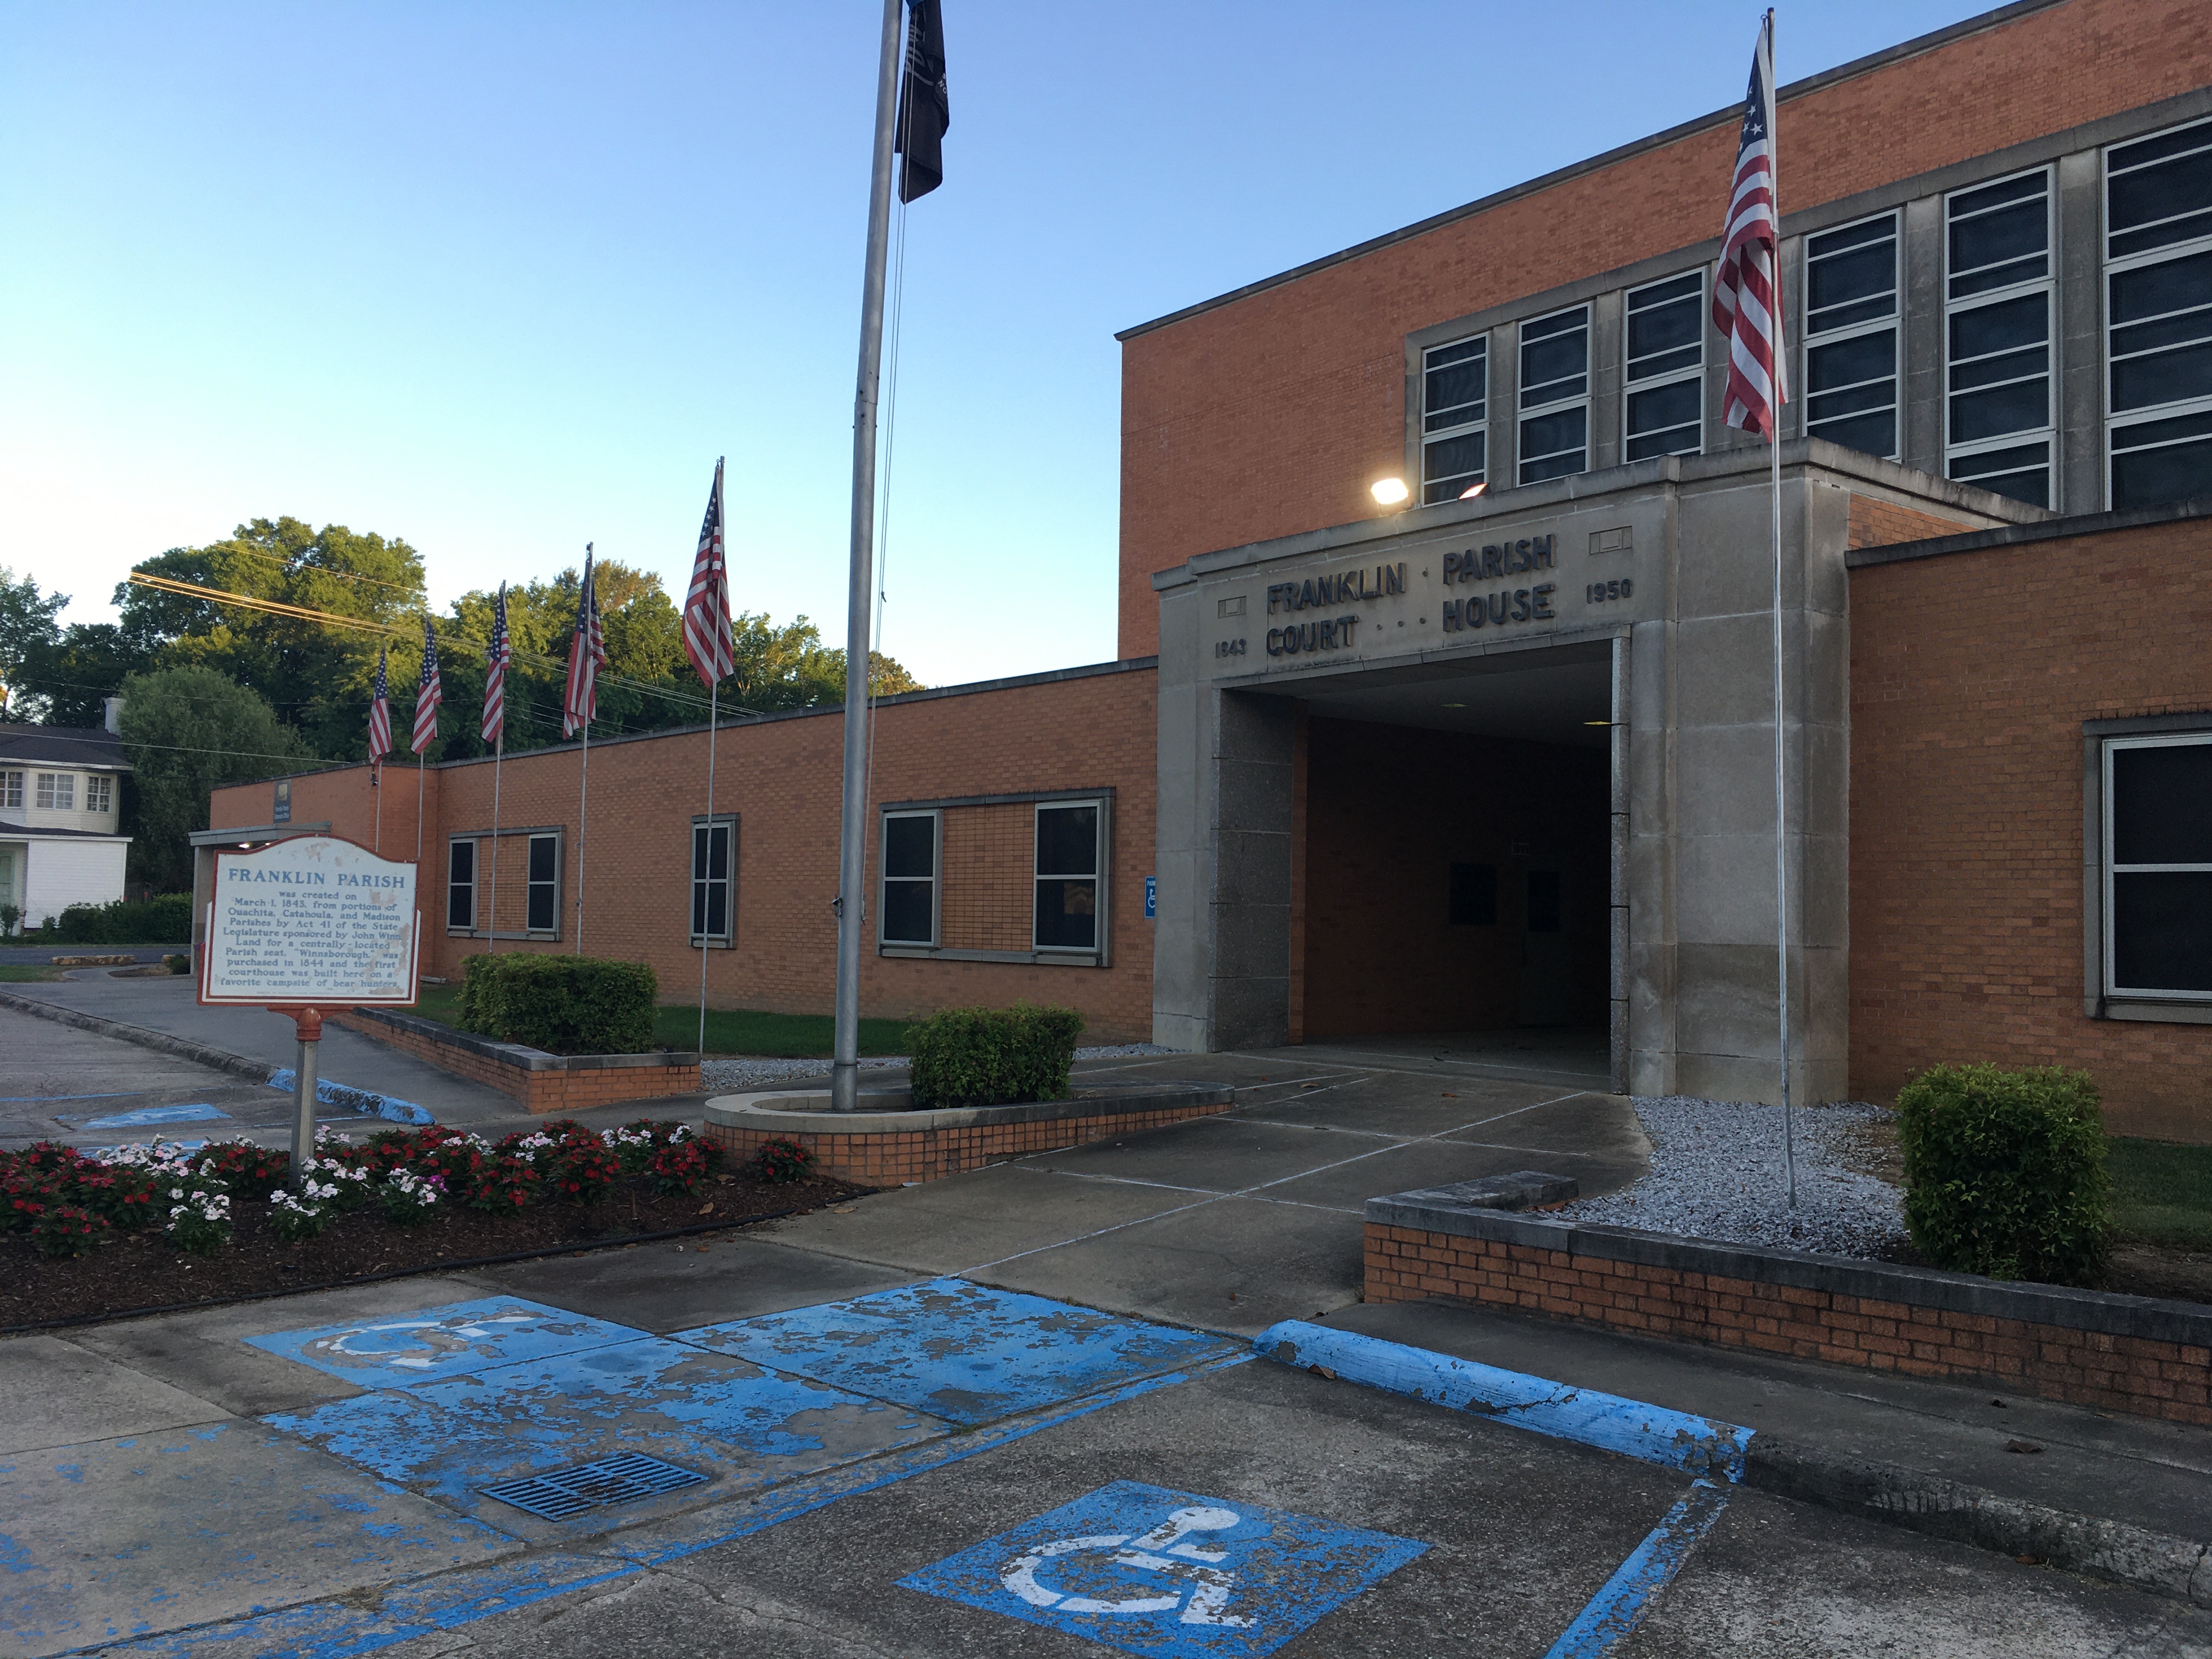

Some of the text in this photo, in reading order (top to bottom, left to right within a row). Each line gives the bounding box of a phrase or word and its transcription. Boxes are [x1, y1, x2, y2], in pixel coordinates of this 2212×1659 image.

[1267, 534, 1556, 614] FRANKLIN PARISH
[1586, 578, 1633, 604] 1950
[1266, 583, 1555, 657] COURT HOUSE
[1215, 639, 1246, 659] 1843
[228, 868, 405, 889] FRANKLIN PARISH
[302, 891, 339, 900] created
[234, 897, 266, 906] March
[313, 900, 336, 909] from
[341, 903, 382, 911] portions
[363, 912, 400, 921] Madison
[229, 917, 271, 926] Parishes
[276, 918, 290, 928] by
[373, 922, 398, 930] State
[223, 927, 280, 938] Legislature
[283, 930, 332, 939] sponsored
[335, 930, 348, 939] by
[235, 937, 261, 946] Land
[225, 947, 257, 956] Parish
[227, 958, 278, 967] purchased
[300, 959, 324, 967] 1844
[228, 968, 285, 977] courthouse
[314, 969, 337, 977] built
[220, 977, 261, 986] favorite
[267, 979, 310, 988] campsite
